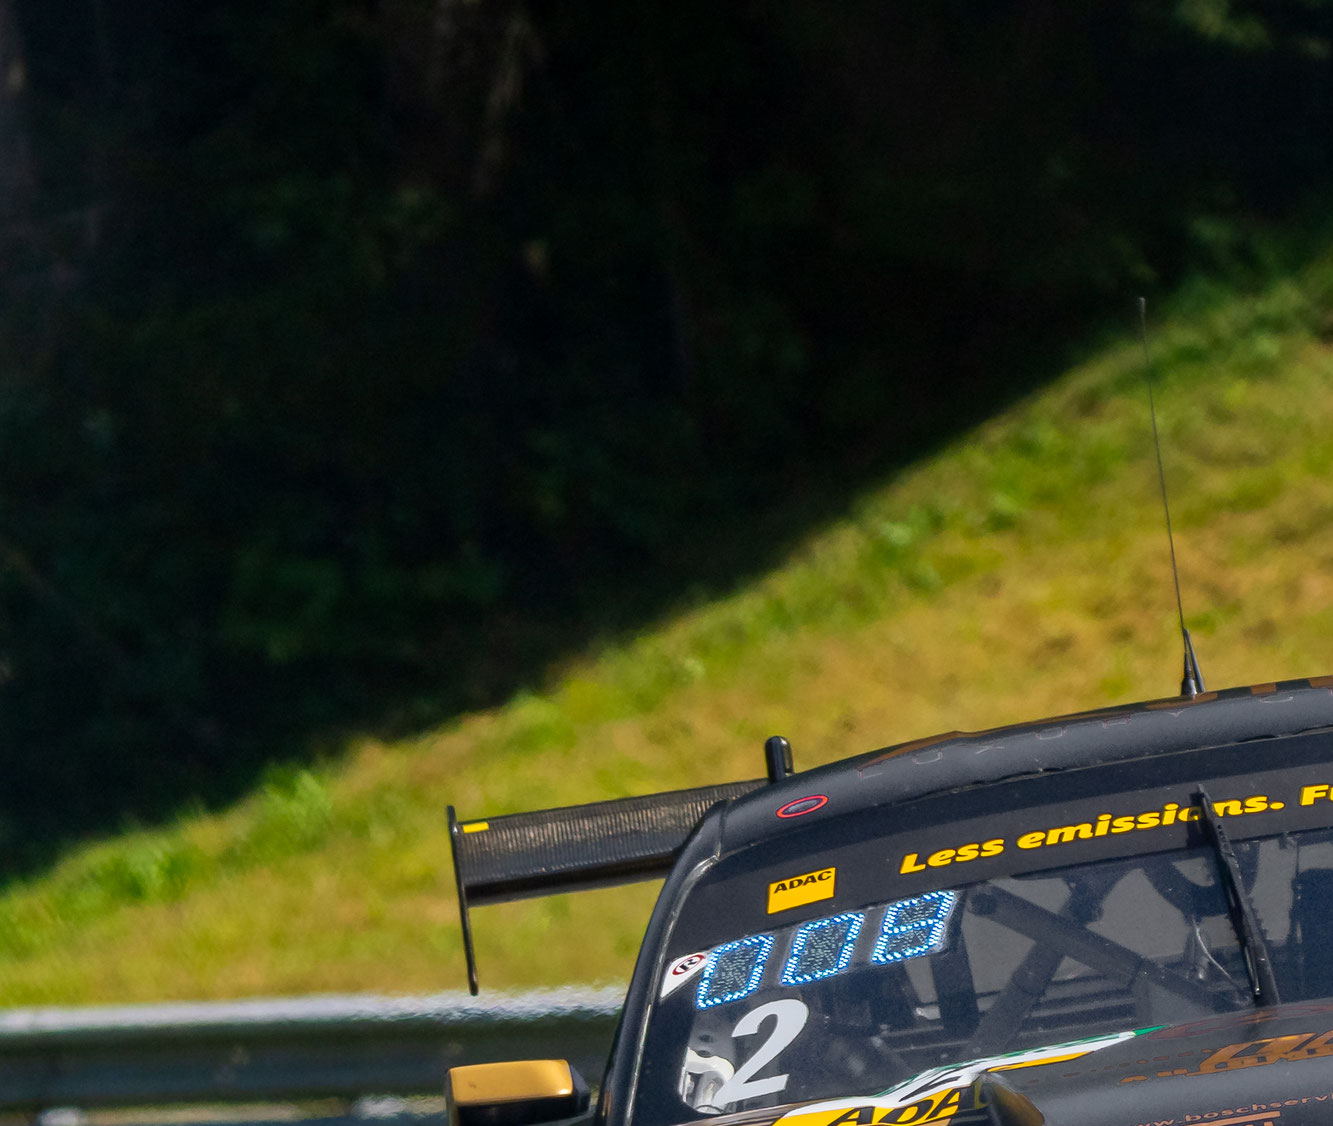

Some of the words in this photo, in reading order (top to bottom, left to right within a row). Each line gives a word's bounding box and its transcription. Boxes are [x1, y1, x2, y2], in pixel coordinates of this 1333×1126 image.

[900, 838, 1005, 875] Less
[1016, 795, 1285, 850] emissions.
[773, 870, 833, 894] ADAC
[714, 998, 810, 1107] 2
